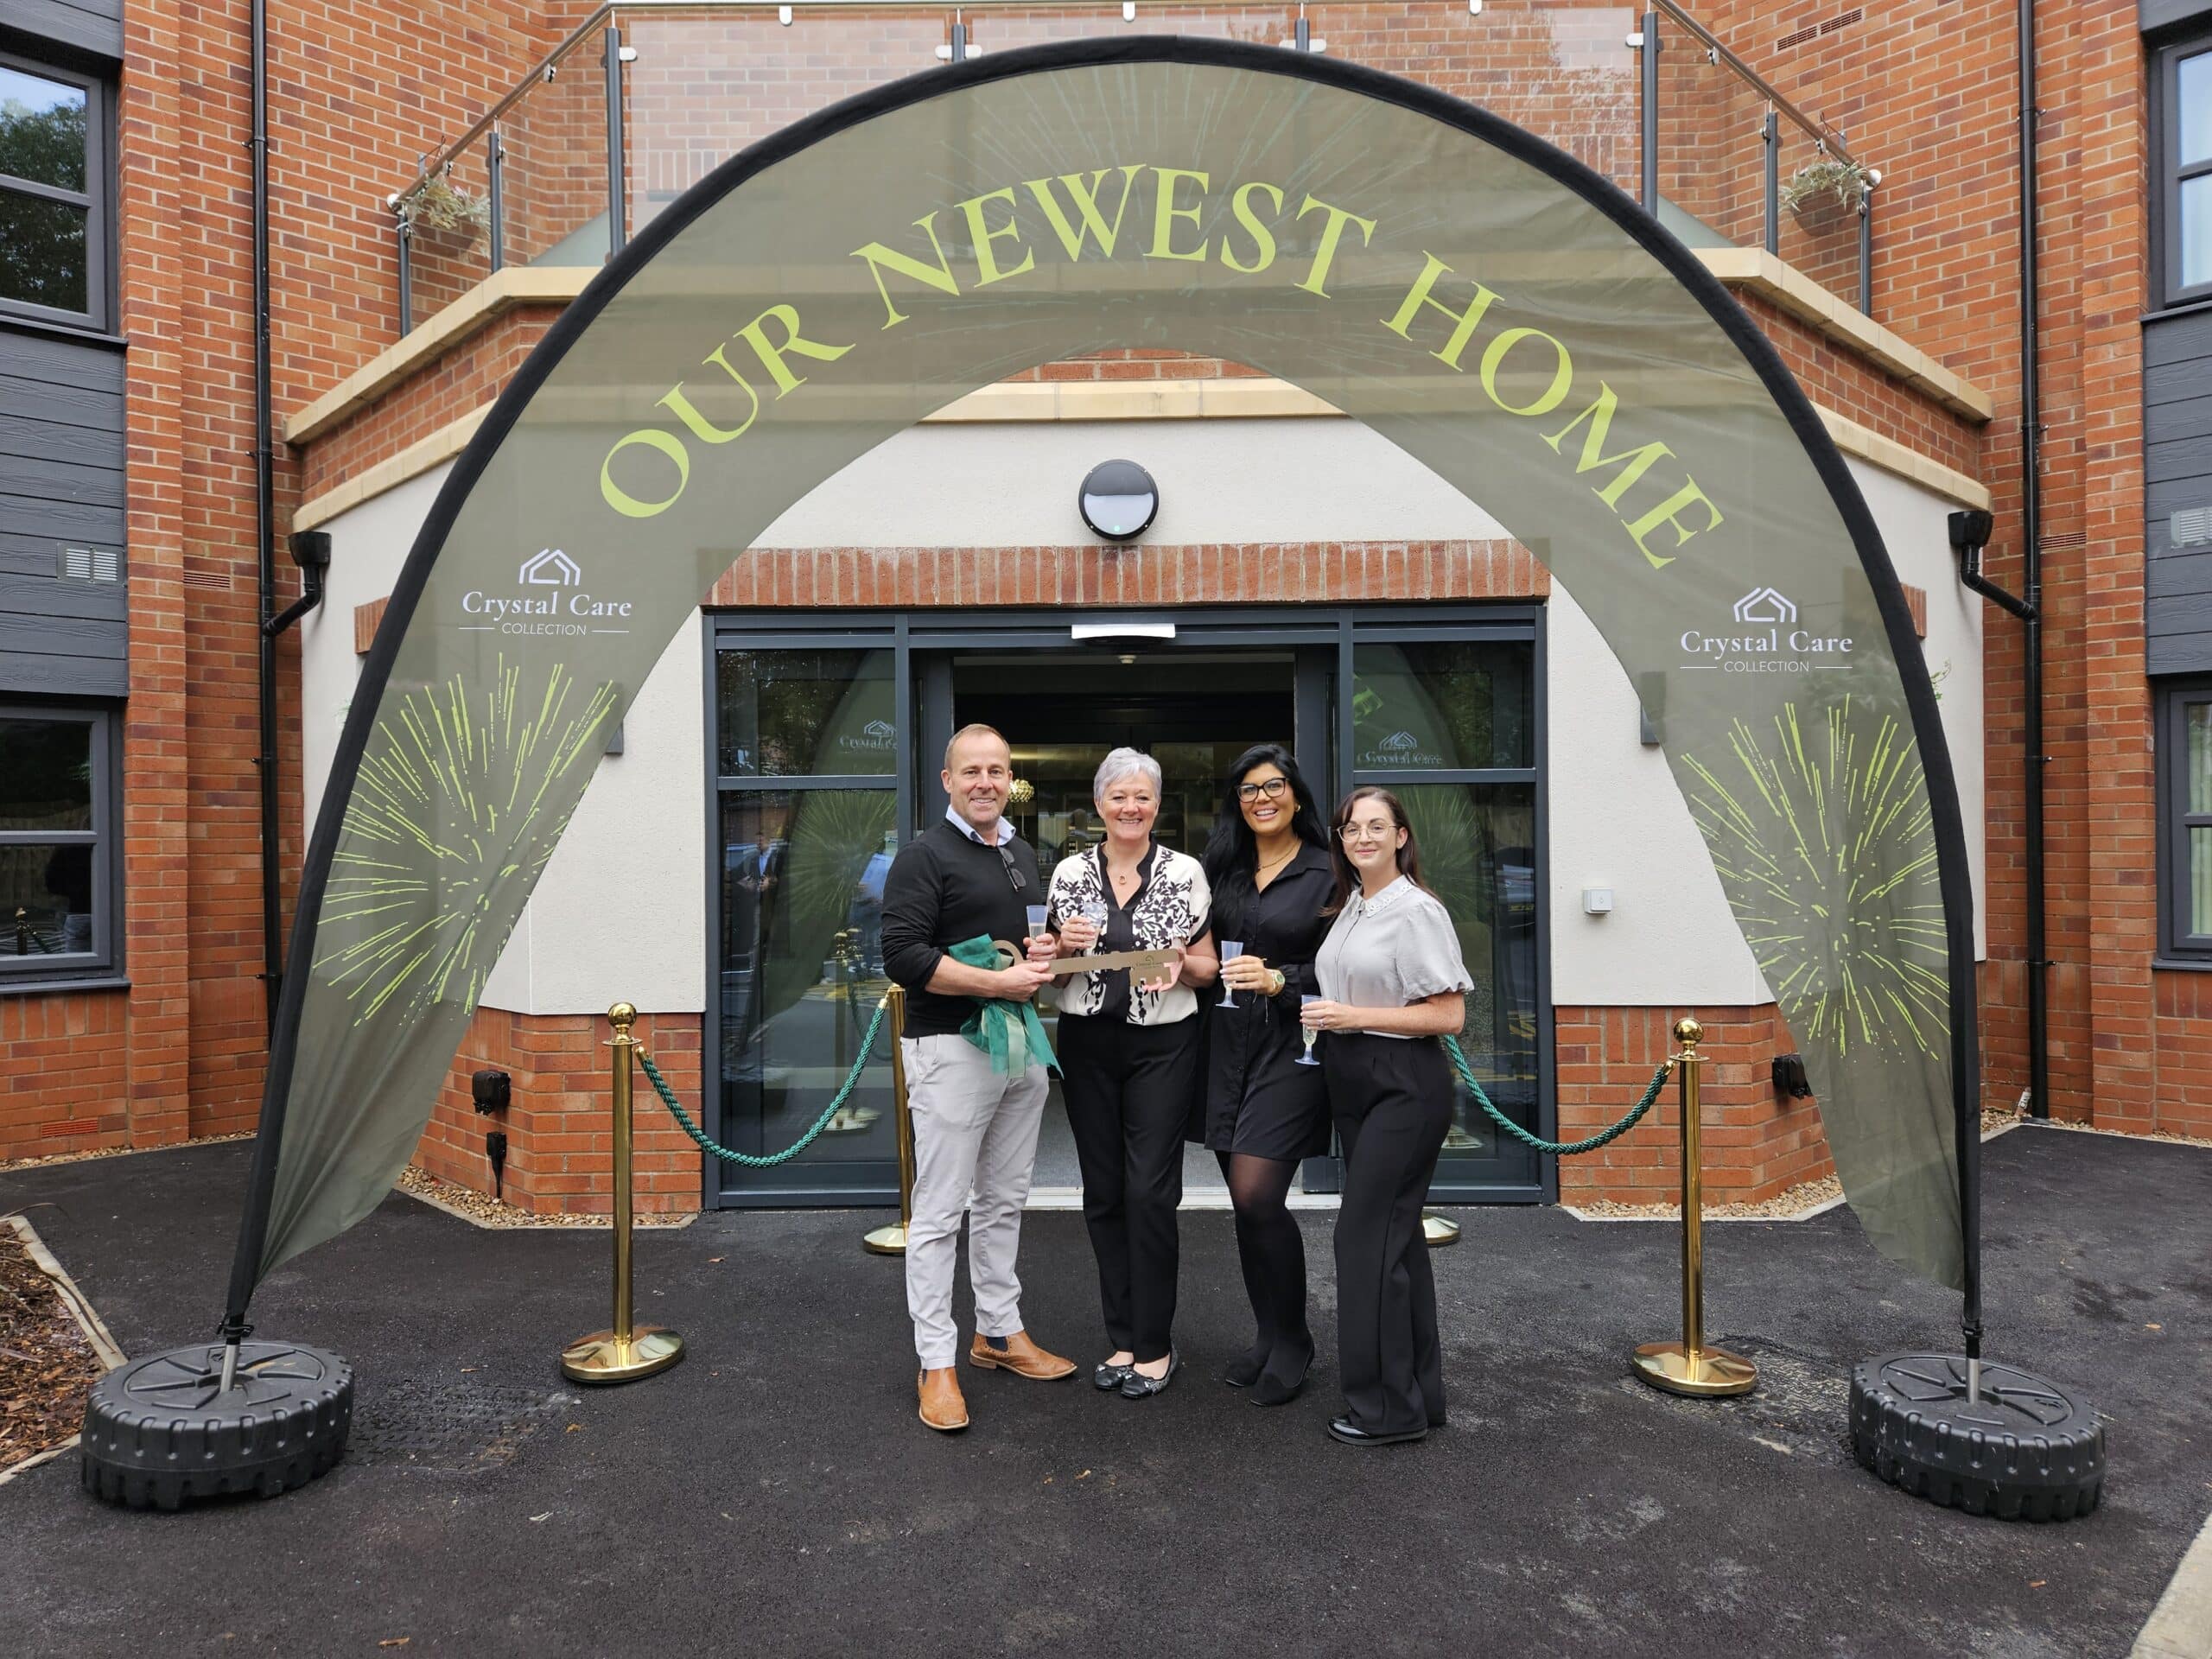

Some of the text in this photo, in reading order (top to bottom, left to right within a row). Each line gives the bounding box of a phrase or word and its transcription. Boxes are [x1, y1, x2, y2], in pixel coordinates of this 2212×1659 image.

[601, 164, 1724, 569] OUR NEWEST HOME
[462, 591, 632, 622] Crystal Care
[501, 622, 588, 636] COLLECTION
[1680, 628, 1853, 660] Crystal Care
[1724, 661, 1810, 673] COLLECTION
